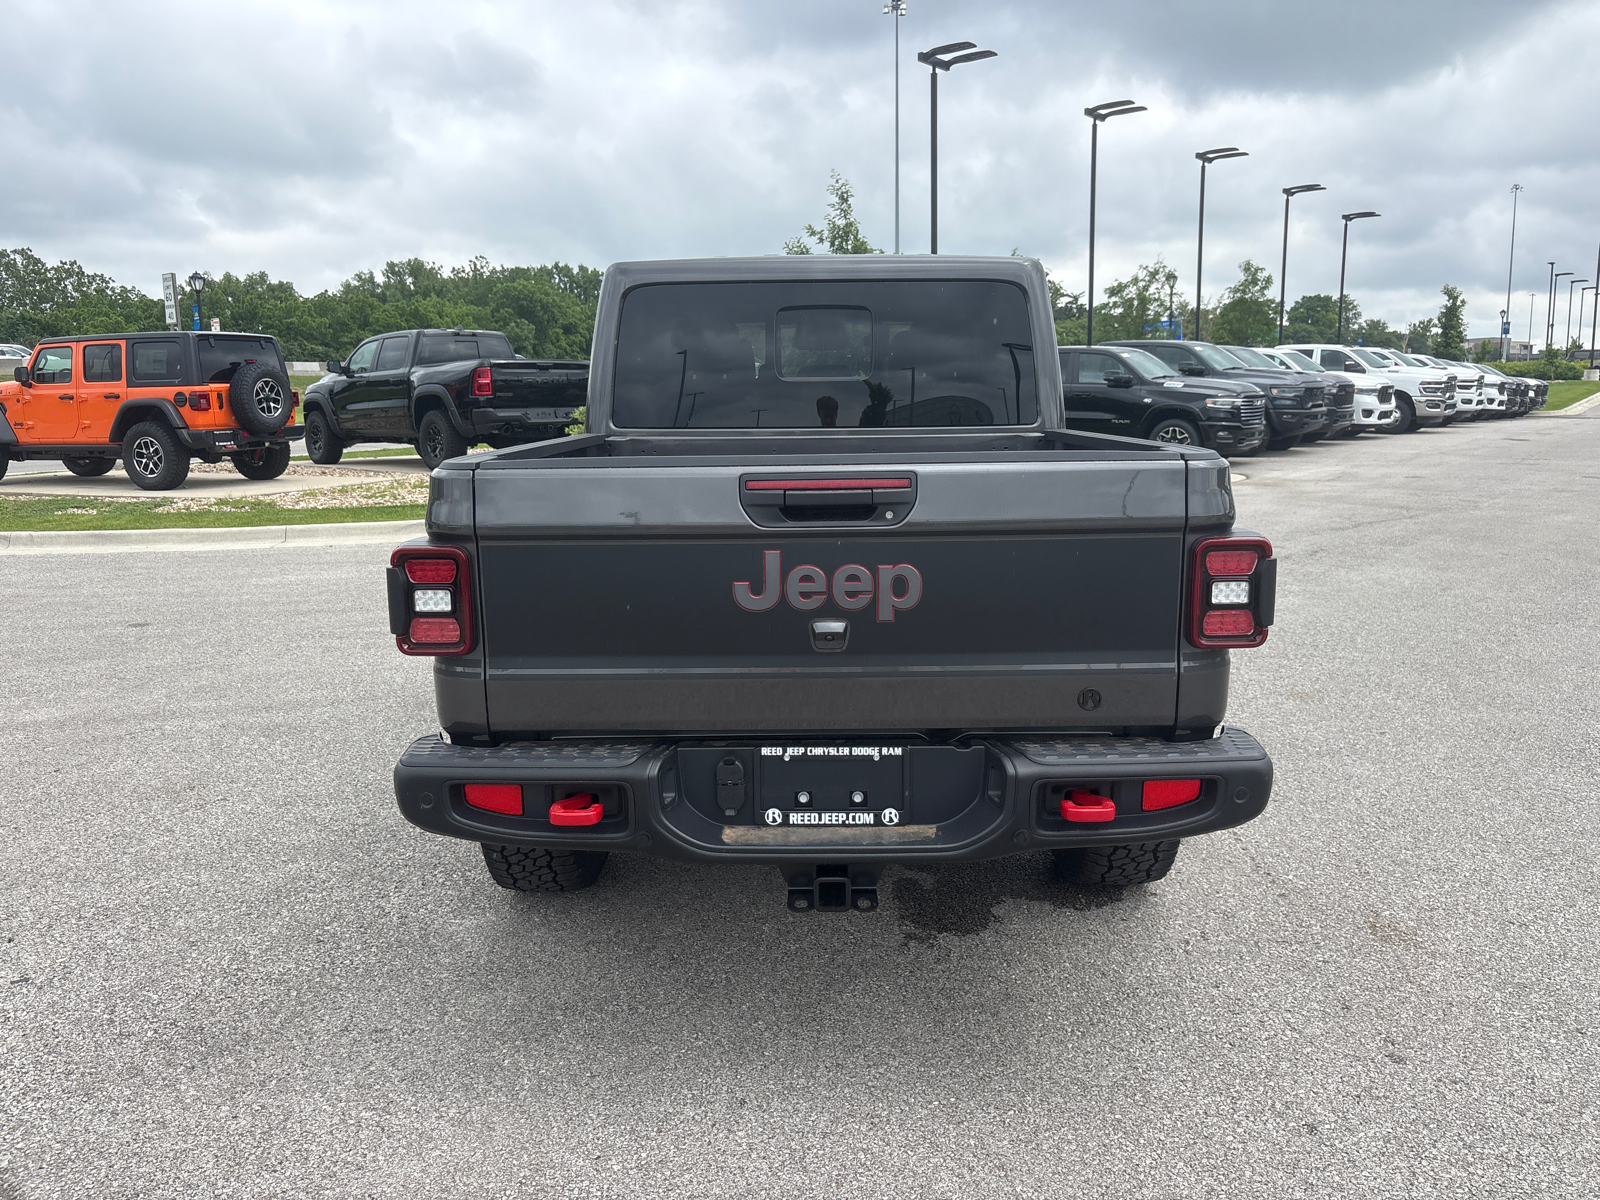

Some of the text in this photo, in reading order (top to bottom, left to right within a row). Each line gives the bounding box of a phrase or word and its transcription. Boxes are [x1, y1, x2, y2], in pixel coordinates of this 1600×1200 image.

[165, 292, 173, 302] 60
[168, 311, 175, 320] 40
[732, 549, 923, 623] Jeep
[761, 746, 903, 756] REED JEEP CHRYSLER DODGE RAM
[789, 812, 874, 825] REEDJEEP.COM
